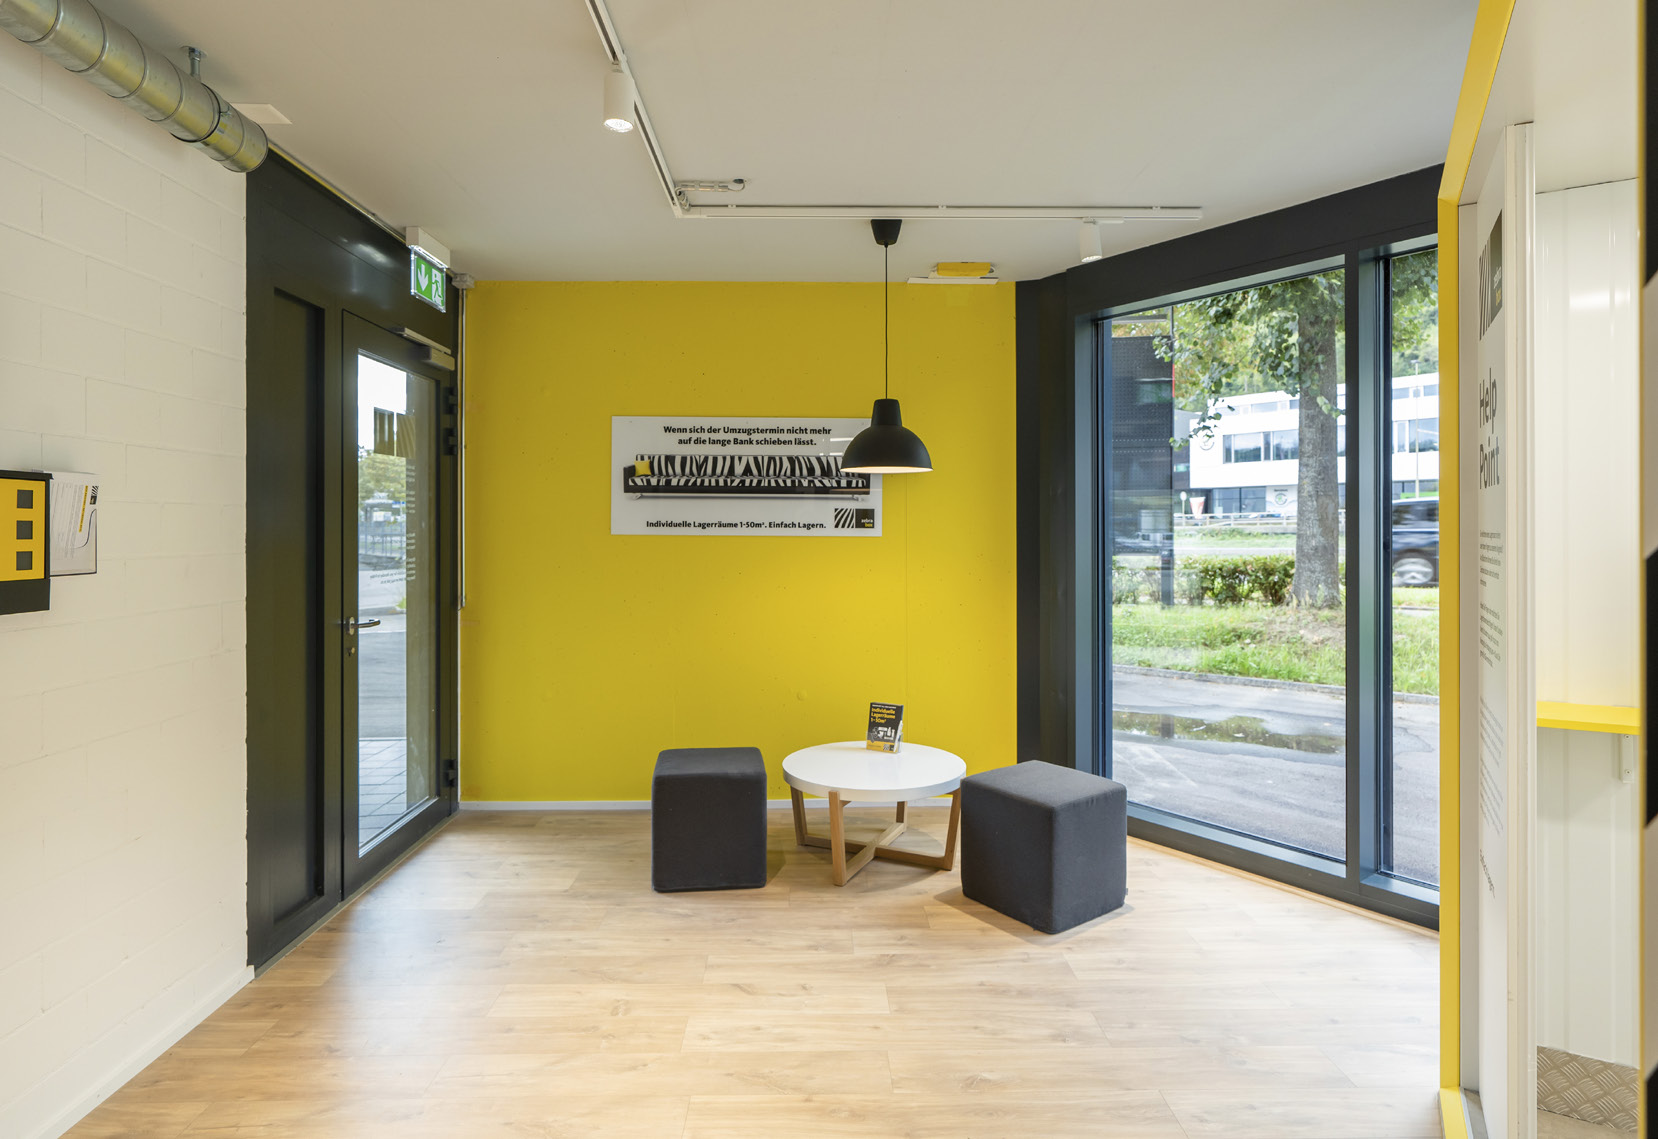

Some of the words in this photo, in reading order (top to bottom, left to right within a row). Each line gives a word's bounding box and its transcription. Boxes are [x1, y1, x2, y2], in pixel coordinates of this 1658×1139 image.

[1479, 367, 1498, 435] Help
[663, 425, 688, 434] Wenn
[688, 425, 706, 434] sich
[706, 425, 721, 434] der
[722, 426, 785, 436] Umzugstermin
[786, 426, 808, 435] nicht
[809, 426, 832, 435] mehr
[677, 436, 693, 445] auf
[693, 436, 707, 445] die
[708, 436, 732, 447] lange
[733, 437, 754, 446] Bank
[755, 437, 793, 446] schieben
[794, 437, 817, 446] lässt.
[1479, 436, 1500, 490] Point
[646, 520, 692, 528] Individuelle
[693, 520, 739, 530] Lagerräume
[768, 521, 797, 529] Einfach
[797, 521, 827, 531] Lagern.
